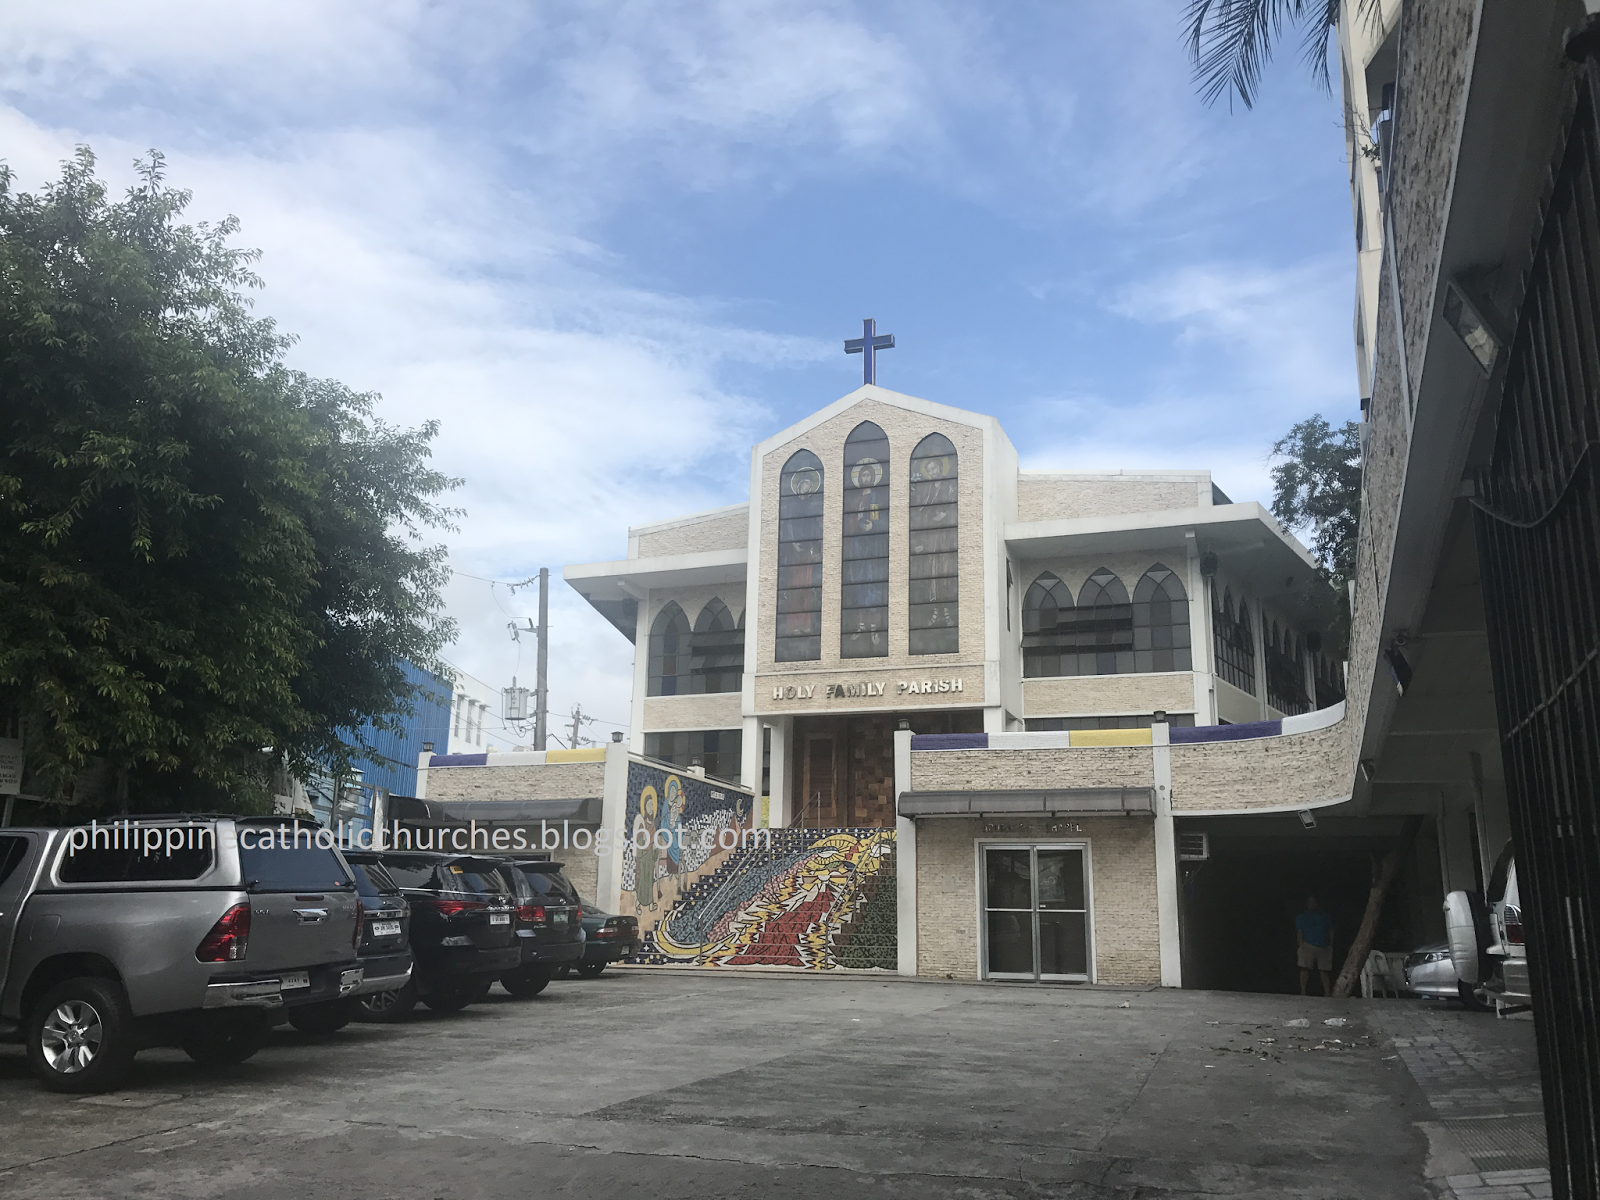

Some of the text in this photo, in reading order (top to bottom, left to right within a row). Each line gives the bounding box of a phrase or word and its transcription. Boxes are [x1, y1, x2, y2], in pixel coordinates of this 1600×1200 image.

[772, 678, 964, 700] HOLY FAMILY PARISH
